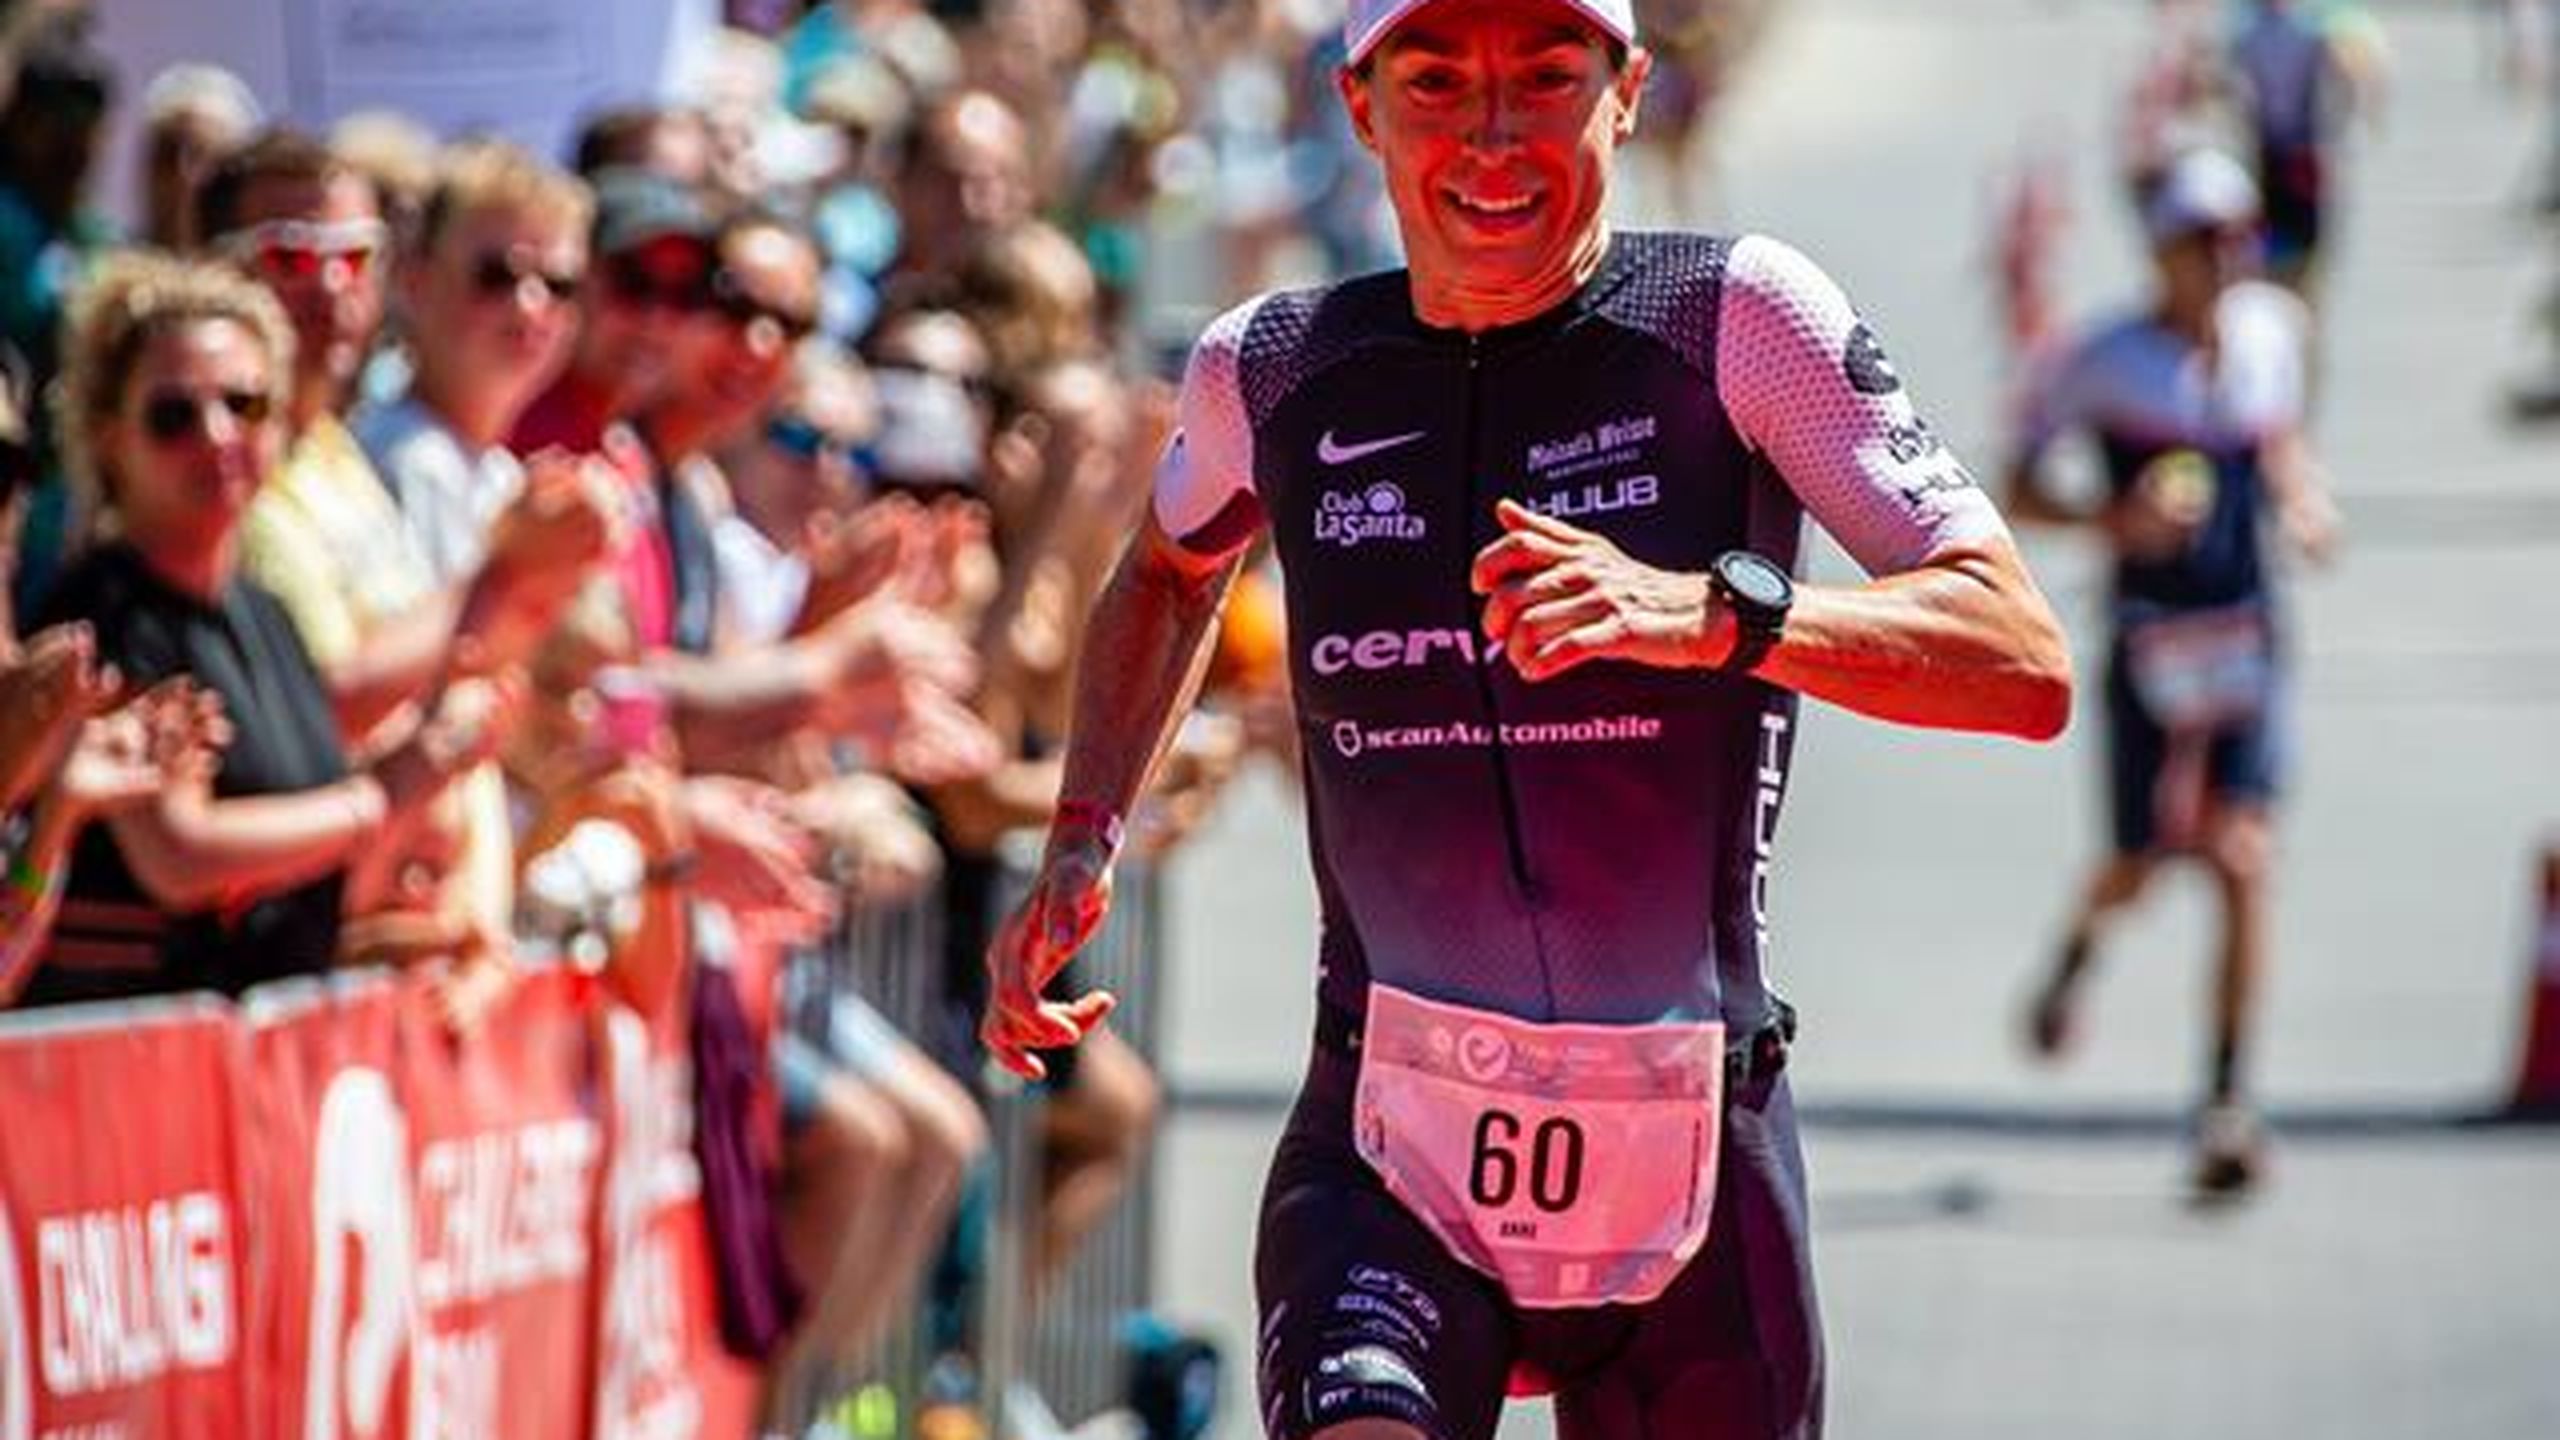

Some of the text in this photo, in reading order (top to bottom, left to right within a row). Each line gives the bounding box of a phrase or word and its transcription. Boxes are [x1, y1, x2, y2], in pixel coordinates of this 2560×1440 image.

[1322, 490, 1364, 513] Club
[1527, 475, 1658, 517] HUUB
[1311, 629, 1505, 675] cerv
[1366, 715, 1662, 748] scanAutomobile
[1470, 1109, 1584, 1213] 60
